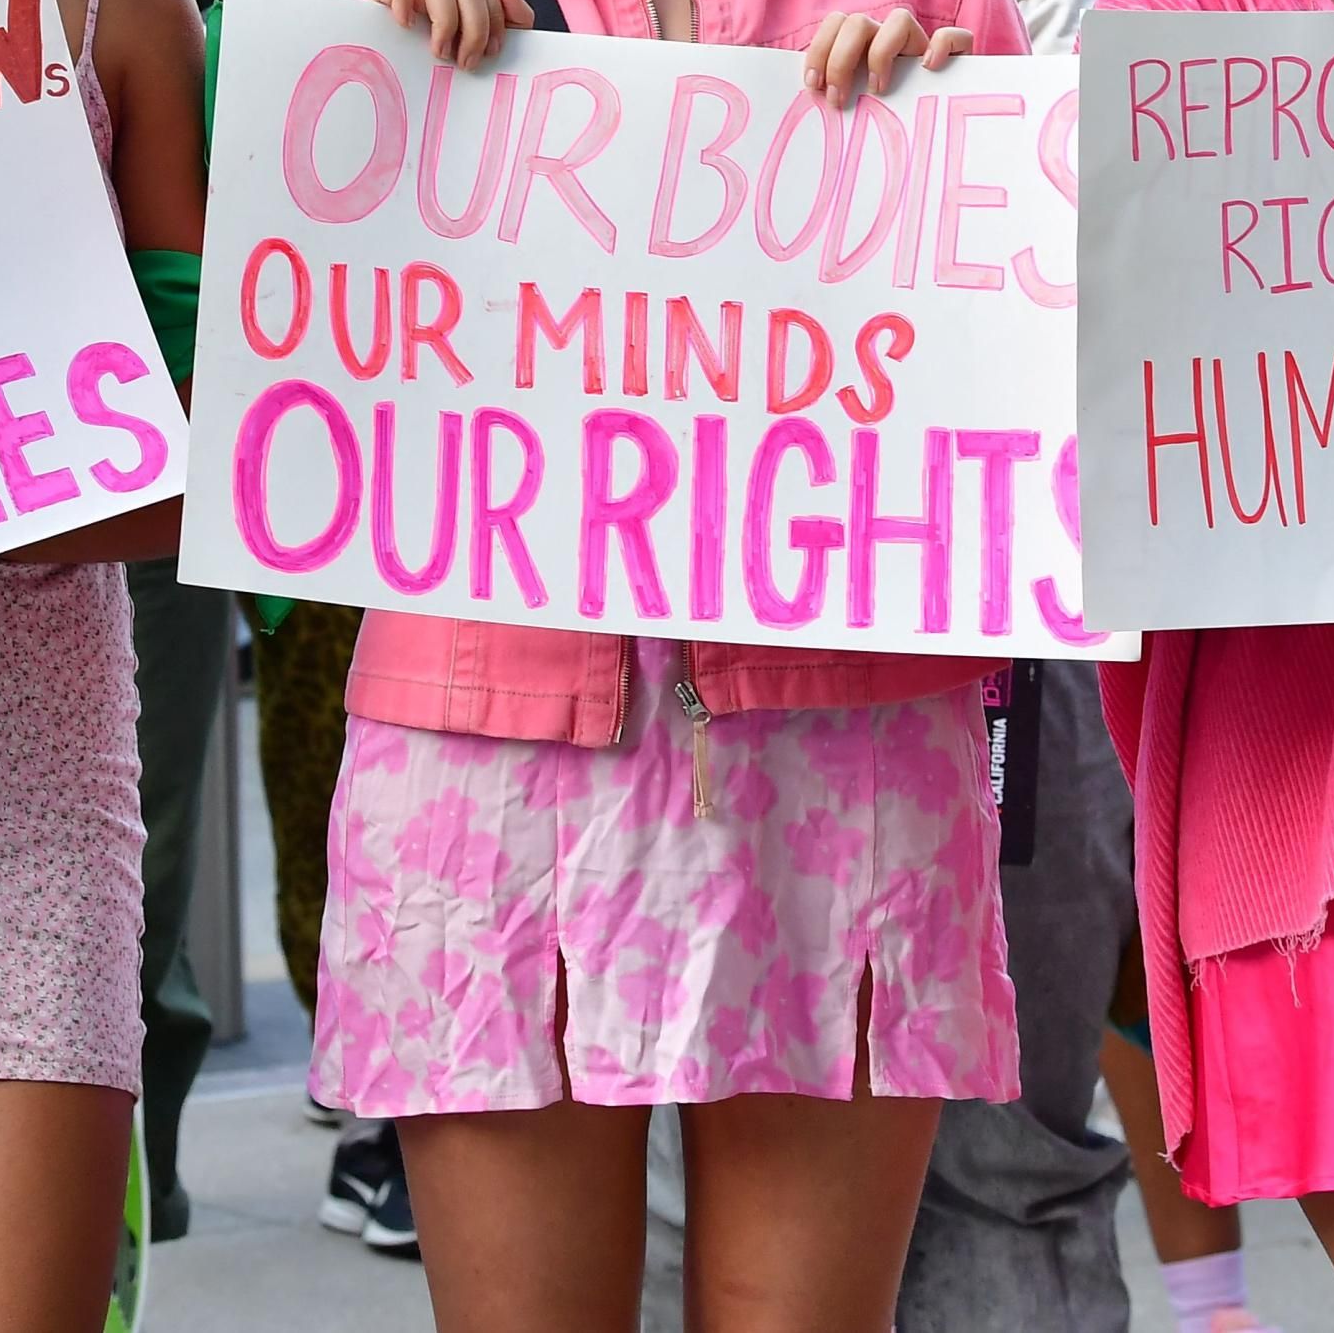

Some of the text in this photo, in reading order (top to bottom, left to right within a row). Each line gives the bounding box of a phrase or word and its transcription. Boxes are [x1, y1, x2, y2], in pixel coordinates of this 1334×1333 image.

[282, 44, 622, 256] OUR
[239, 236, 917, 424] OUR MINDS
[233, 378, 550, 609] OUR
[990, 717, 1008, 805] CALIFORNIA
